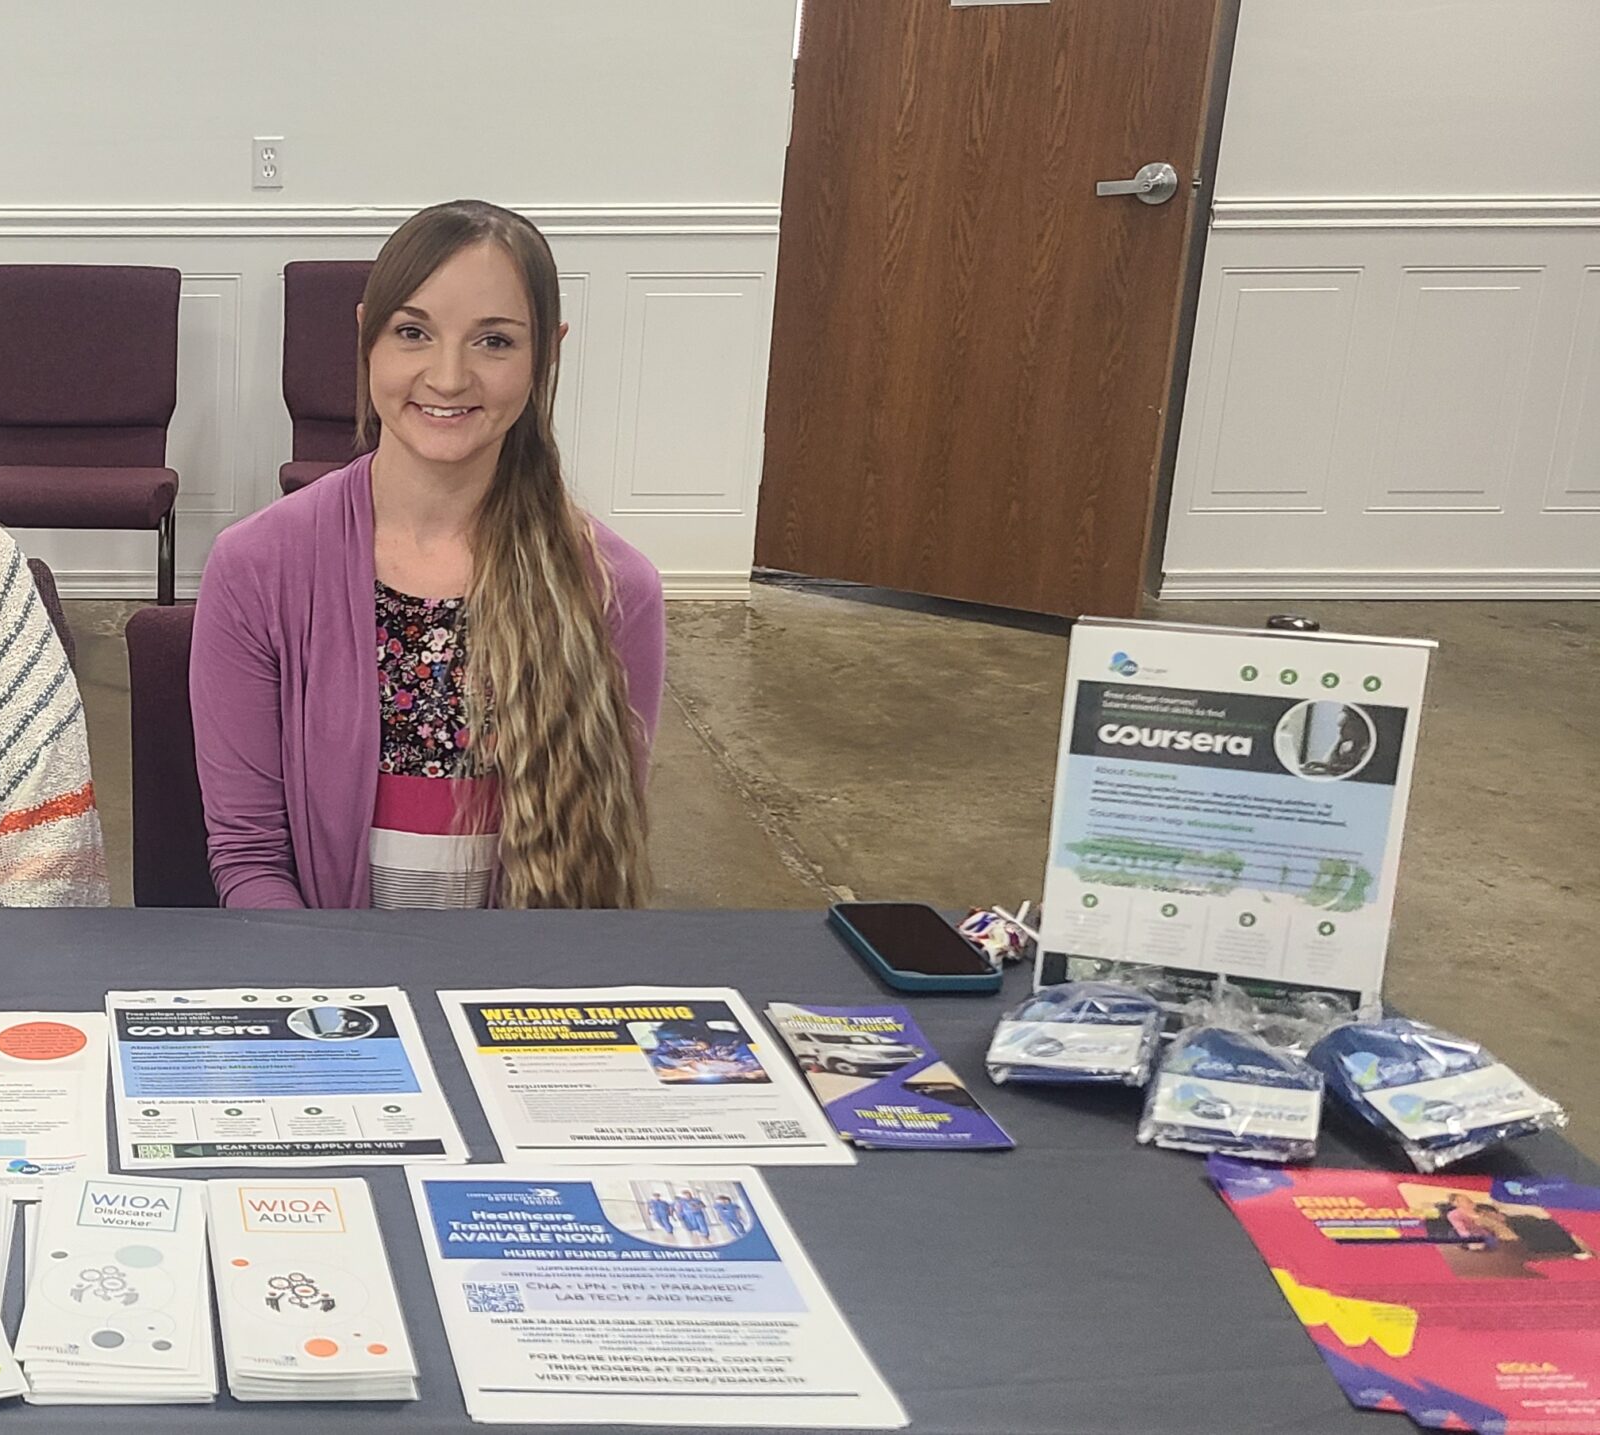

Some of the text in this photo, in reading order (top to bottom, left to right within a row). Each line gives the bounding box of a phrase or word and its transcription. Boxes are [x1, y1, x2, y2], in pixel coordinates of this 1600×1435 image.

[1097, 723, 1253, 758] coursera
[1088, 808, 1136, 820] Coursera
[480, 1006, 695, 1021] WELDING TRAINING
[849, 1016, 894, 1025] TRUCK
[127, 1025, 270, 1036] coursera
[492, 1031, 619, 1040] DISPLACED WORKERS
[91, 1193, 170, 1210] WIOA
[248, 1200, 331, 1212] WIOA
[94, 1206, 162, 1218] Dislocated
[472, 1211, 576, 1221] Healthcare
[102, 1217, 152, 1227] Worker
[259, 1213, 325, 1223] ADULT
[449, 1222, 604, 1233] Training Funding
[448, 1233, 613, 1244] AVAILABLE NOW!
[503, 1249, 720, 1260] HURRY! FUNDS ARE LIMITED!
[526, 1282, 756, 1292] CNA LPN RN PARAMEDIC
[590, 1294, 630, 1302] TECH
[647, 1294, 680, 1302] AND
[685, 1294, 733, 1303] MORE
